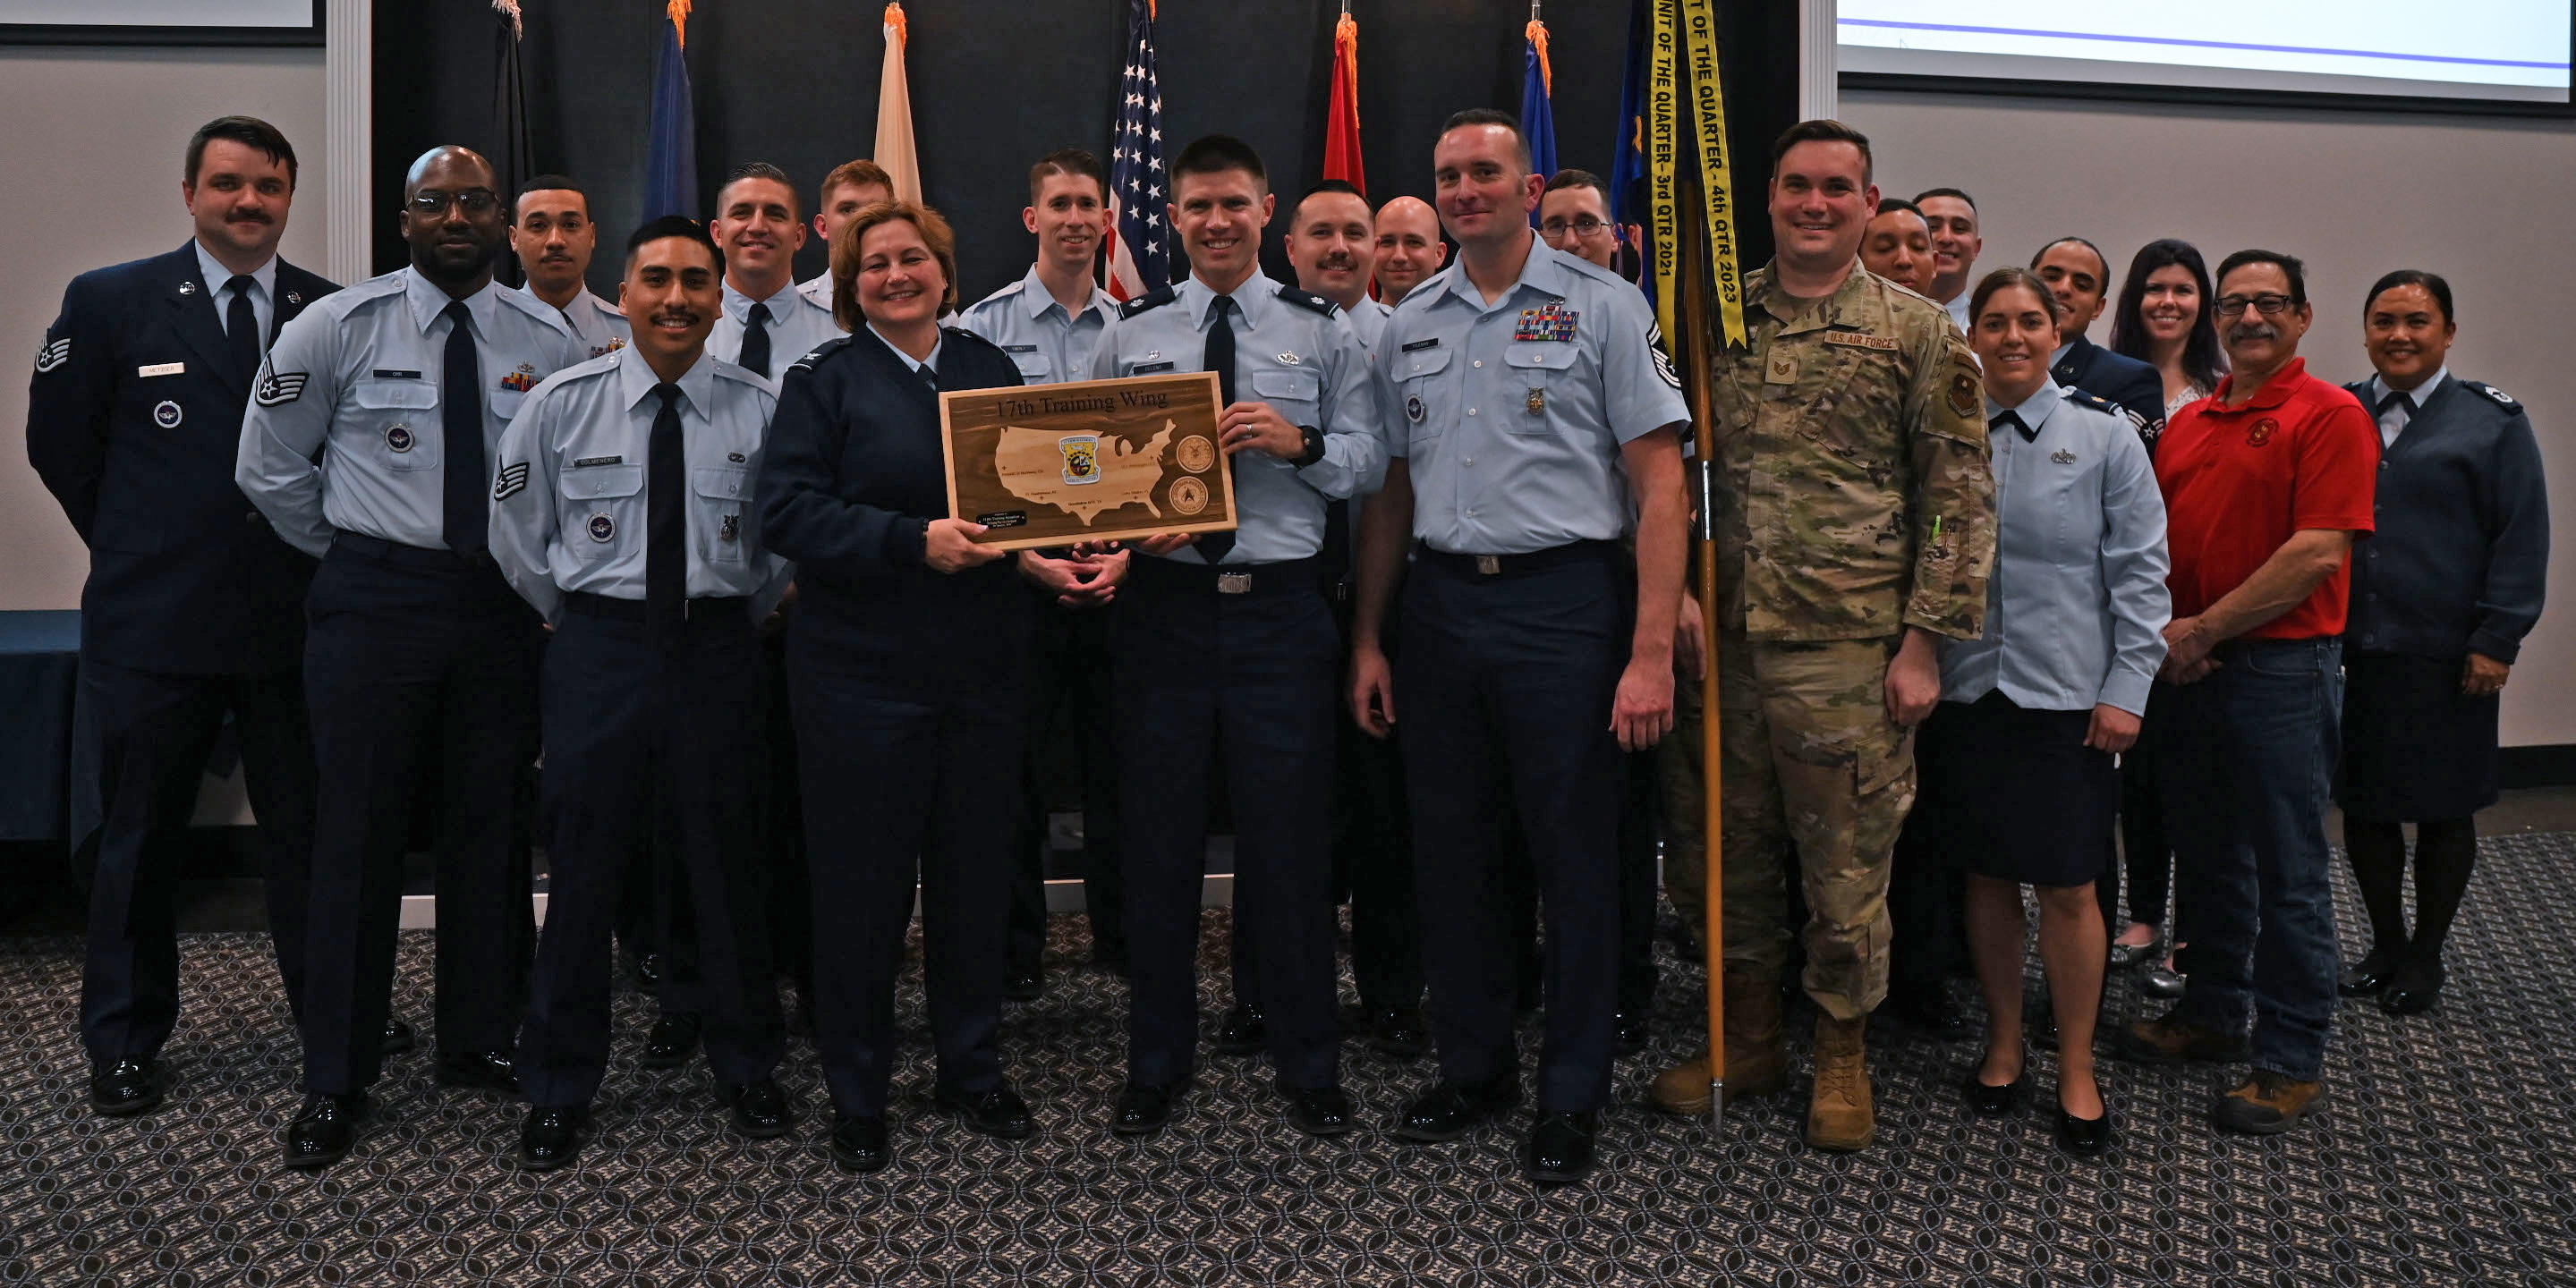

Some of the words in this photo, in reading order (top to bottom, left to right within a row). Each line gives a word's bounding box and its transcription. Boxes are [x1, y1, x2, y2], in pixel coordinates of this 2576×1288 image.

[1658, 0, 1673, 29] NIT
[1692, 15, 1708, 38] OF
[1658, 32, 1671, 53] OF
[1656, 57, 1671, 87] THE
[1696, 44, 1713, 80] THE
[1699, 85, 1722, 170] QUARTER
[1656, 174, 1671, 199] 3rd
[1712, 185, 1726, 214] 4th
[1656, 205, 1672, 236] QTR
[1714, 219, 1730, 256] QTR
[1659, 242, 1672, 276] 2021
[1719, 261, 1737, 303] 2023
[1831, 332, 1845, 343] U.S.
[1848, 335, 1863, 344] AIR
[1865, 336, 1893, 349] FORCE
[997, 399, 1034, 417] 17th
[1039, 394, 1116, 414] Training
[1119, 390, 1168, 409] Wing
[580, 457, 616, 465] COLMENERO
